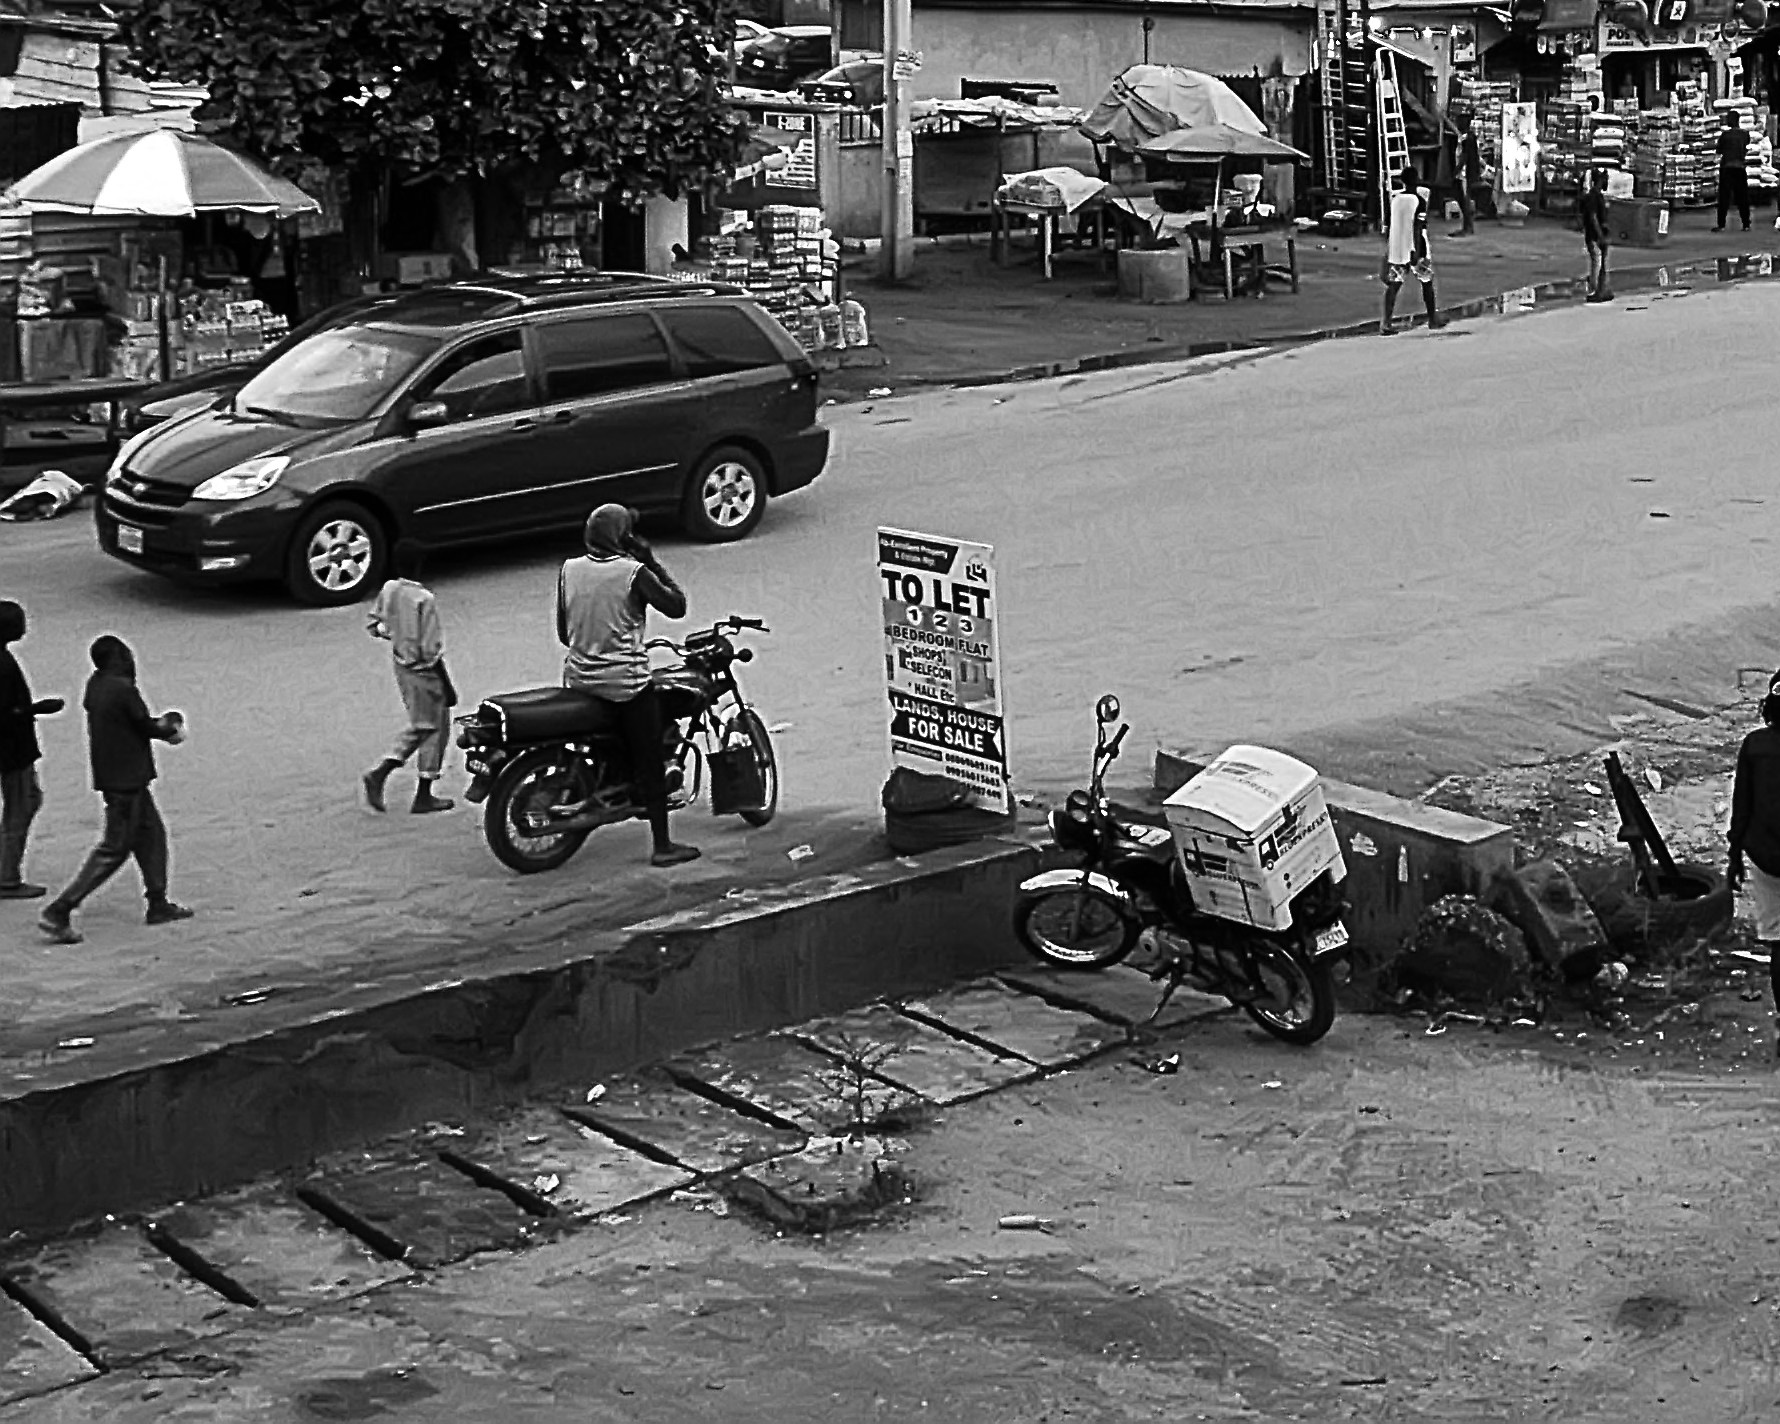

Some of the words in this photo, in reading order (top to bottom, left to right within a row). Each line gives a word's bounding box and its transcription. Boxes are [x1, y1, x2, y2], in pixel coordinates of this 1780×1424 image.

[880, 568, 924, 606] TO
[932, 578, 991, 620] LET
[909, 608, 918, 621] 1
[934, 614, 949, 629] 2
[960, 618, 974, 633] 3
[892, 624, 955, 649] BEDROOM
[958, 638, 989, 657] FLAT
[914, 682, 939, 700] HALL
[893, 696, 944, 724] LANDS,
[946, 708, 996, 735] HOUSE
[907, 716, 940, 742] FOR
[943, 725, 985, 753] SALE
